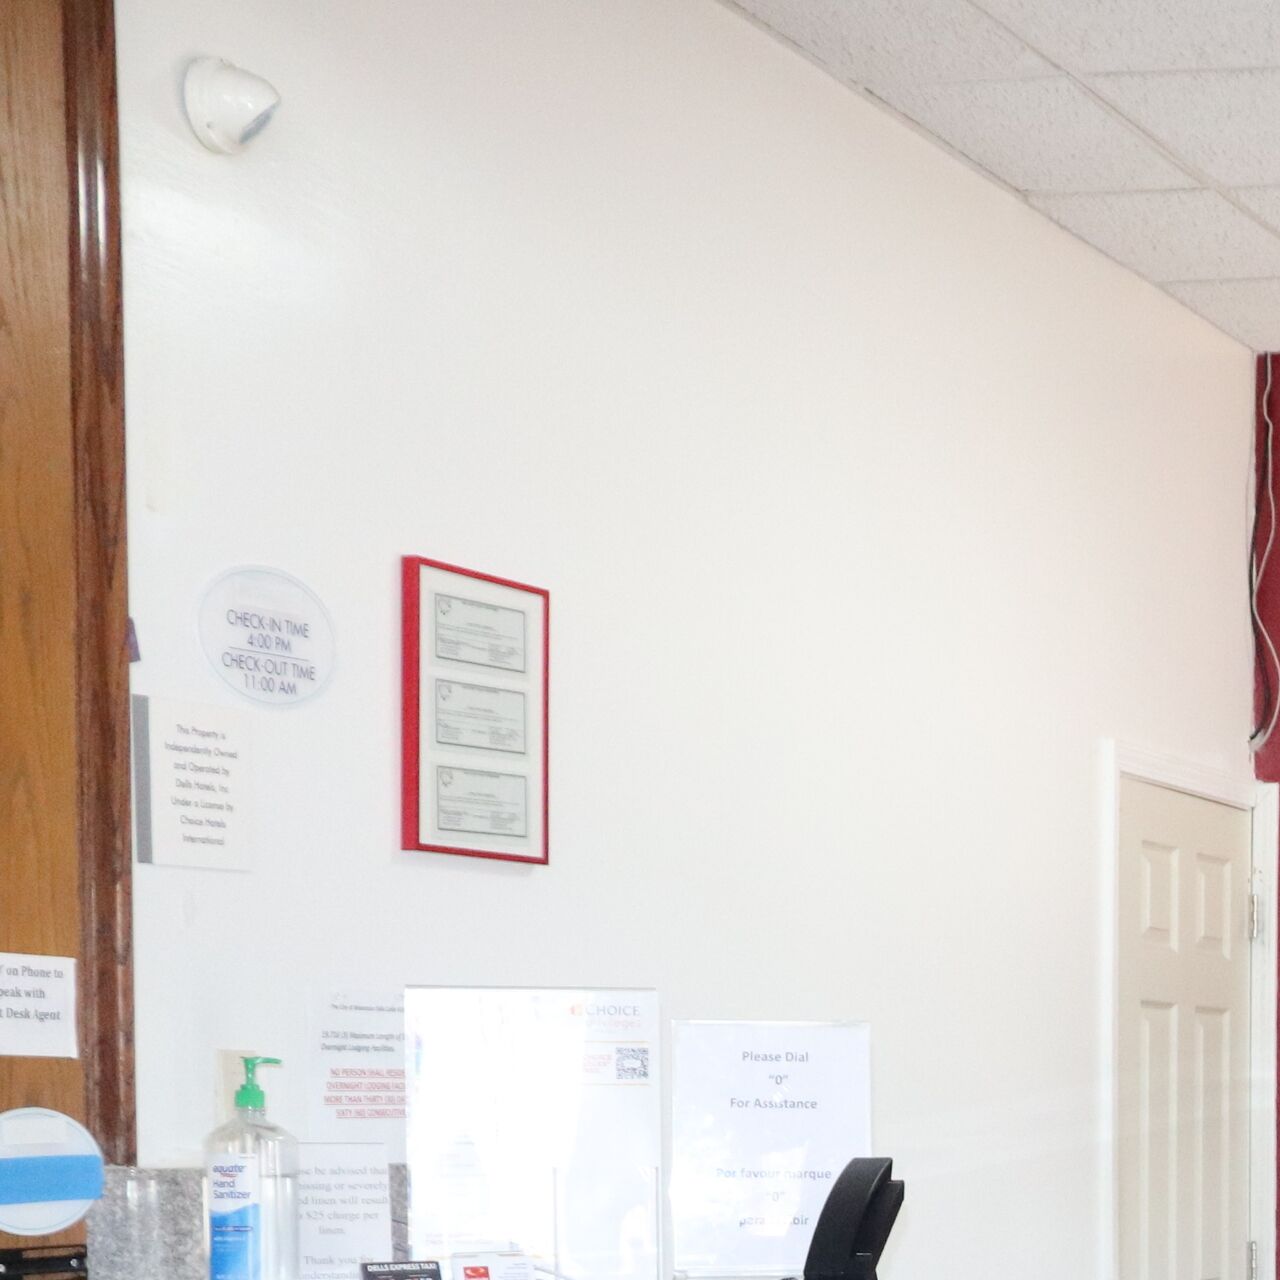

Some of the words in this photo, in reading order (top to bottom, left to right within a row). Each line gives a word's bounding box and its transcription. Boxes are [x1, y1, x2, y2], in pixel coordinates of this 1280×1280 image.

[226, 609, 283, 632] CHECK-IN
[286, 619, 310, 639] TIME
[247, 633, 272, 650] 4:00
[275, 636, 293, 653] PM
[221, 651, 289, 676] CHECK-OUT
[292, 662, 316, 681] TIME
[245, 673, 275, 693] 11:00
[277, 680, 297, 695] AM
[6, 967, 19, 977] on
[21, 965, 52, 978] Phone
[54, 968, 65, 979] to
[24, 988, 45, 999] with
[6, 1007, 30, 1019] Desk
[33, 1008, 61, 1022] Agent
[586, 1005, 641, 1016] CHOICE
[742, 1050, 782, 1062] Please
[785, 1051, 809, 1062] Dial
[730, 1097, 751, 1109] For
[754, 1098, 818, 1109] Assistance
[212, 1179, 236, 1188] Hand
[212, 1190, 252, 1199] Sanitizer
[327, 1211, 360, 1222] charge
[303, 1255, 335, 1265] Thank
